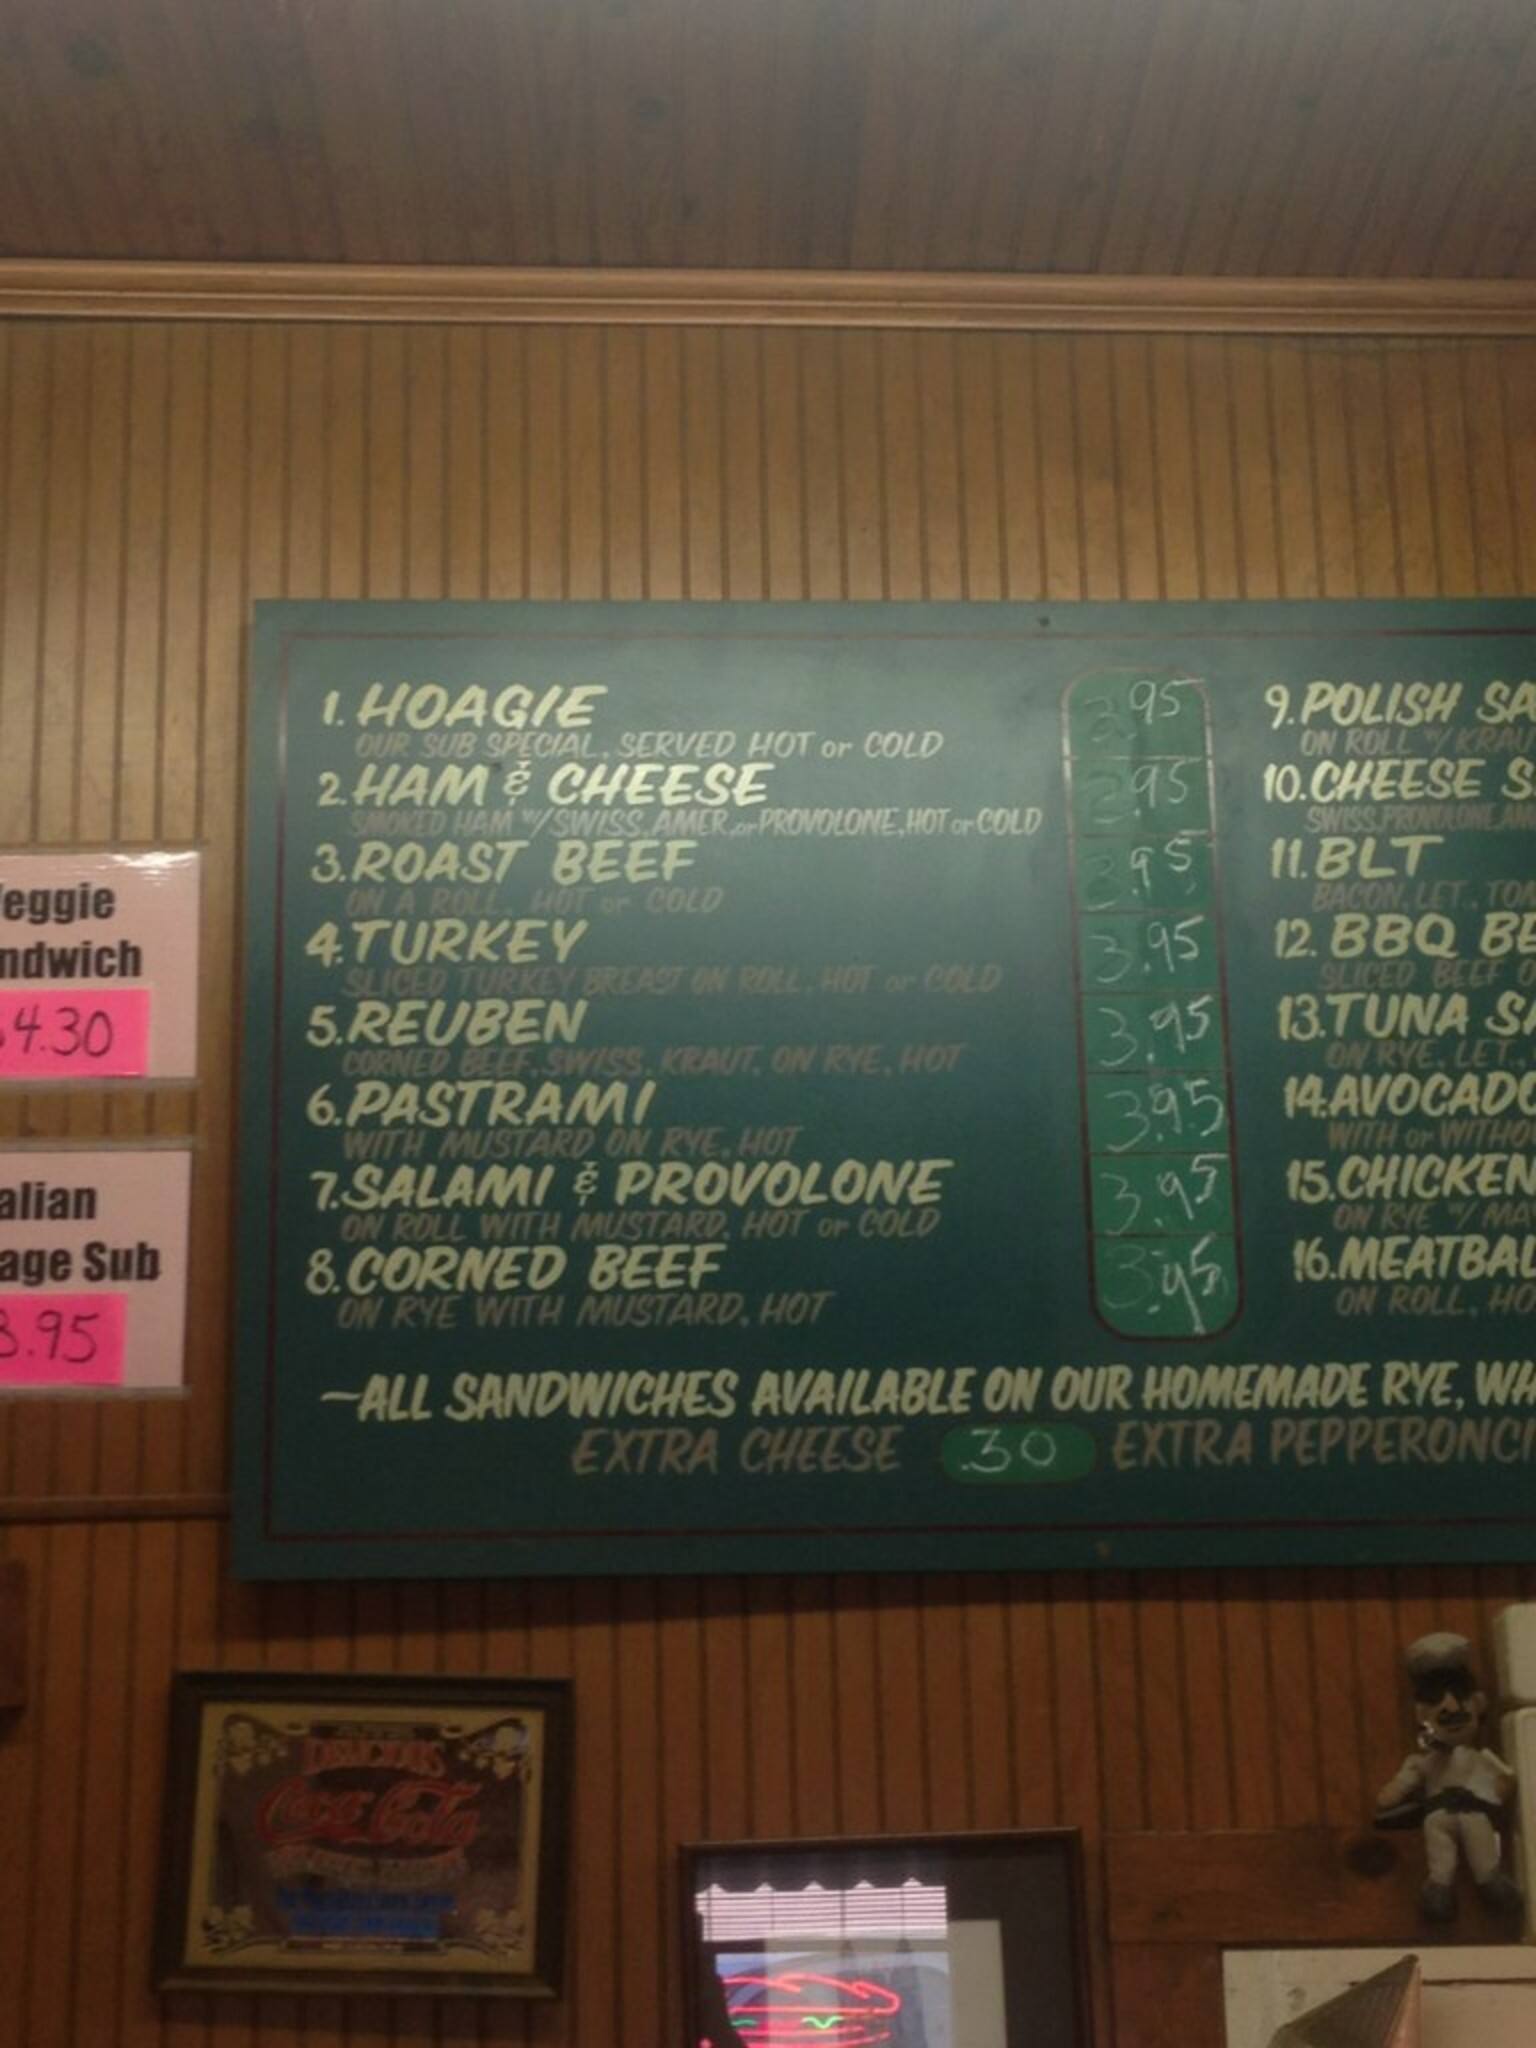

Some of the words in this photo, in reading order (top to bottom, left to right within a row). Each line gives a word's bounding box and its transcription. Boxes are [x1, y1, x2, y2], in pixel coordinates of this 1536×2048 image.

[321, 690, 345, 727] 1.
[357, 682, 608, 730] HOAGIE
[1264, 684, 1295, 731] 9.
[1301, 681, 1463, 728] POLISH
[355, 731, 410, 758] OUR
[423, 731, 477, 758] SUB
[618, 730, 736, 759] SERVED
[749, 730, 816, 758] HOT
[864, 730, 944, 759] COLD
[1300, 727, 1338, 757] ON
[1344, 726, 1411, 757] ROLL
[317, 771, 347, 807] 2.
[352, 763, 491, 807] HAM
[503, 760, 531, 807] &
[546, 762, 775, 807] CHEESE
[1263, 763, 1307, 803] 10.
[1309, 757, 1487, 803] CHEESE
[1500, 755, 1536, 801] S
[350, 808, 446, 838] SMOKED
[453, 808, 513, 837] HAM
[976, 807, 1042, 836] COLD
[310, 843, 347, 883] 3.
[352, 840, 530, 884] ROAST
[553, 839, 698, 885] BEEF
[1271, 837, 1308, 879] 11.
[1314, 834, 1445, 881] BLT
[0, 882, 115, 925] eggie
[345, 887, 386, 917] ON
[394, 887, 415, 916] A
[530, 886, 597, 916] HOT
[645, 886, 724, 915] COLD
[305, 921, 344, 968] 4.
[352, 919, 589, 965] TURKEY
[1088, 916, 1204, 982] 3.95
[1275, 918, 1318, 959] 12.
[1330, 912, 1459, 959] BBQ
[0, 939, 142, 980] ndwich
[341, 966, 447, 997] SLICED
[458, 966, 574, 996] TURKEY
[584, 965, 686, 995] BREAST
[690, 965, 729, 994] ON
[820, 964, 876, 993] HOT
[925, 963, 1003, 994] COLD
[1318, 958, 1416, 991] SLICED
[1431, 957, 1504, 990] BEEF
[306, 1005, 344, 1047] 5.
[347, 999, 589, 1047] REUBEN
[1099, 994, 1213, 1066] 3.95
[1278, 993, 1327, 1041] 13.
[1325, 992, 1470, 1039] TUNA
[342, 1047, 450, 1077] CORNED
[770, 1044, 818, 1075] ON
[901, 1042, 967, 1074] HOT
[306, 1084, 343, 1126] 6.
[346, 1080, 657, 1127] PASTRAMI
[1105, 1078, 1224, 1152] 3.95
[342, 1128, 425, 1161] WITH
[438, 1127, 595, 1160] MUSTARD
[605, 1127, 649, 1158] ON
[738, 1124, 805, 1157] HOT
[1328, 1119, 1400, 1150] WITH
[0, 1181, 97, 1220] alian
[309, 1171, 340, 1211] 7.
[340, 1163, 556, 1211] SALAMI
[573, 1161, 599, 1206] &
[614, 1158, 954, 1207] PROVOLONE
[1100, 1153, 1228, 1235] 3.95
[1286, 1159, 1336, 1204] 15.
[1337, 1153, 1536, 1199] CHICKEN
[341, 1213, 384, 1242] ON
[391, 1212, 467, 1242] ROLL
[479, 1211, 561, 1241] WITH
[740, 1207, 811, 1240] HOT
[858, 1207, 941, 1238] COLD
[1333, 1203, 1374, 1231] ON
[1380, 1202, 1435, 1230] RYE
[0, 1249, 72, 1287] age
[83, 1242, 161, 1282] Sub
[305, 1248, 340, 1295] 8.
[346, 1245, 568, 1295] CORNED
[588, 1243, 728, 1292] BEEF
[337, 1297, 384, 1329] ON
[391, 1296, 458, 1329] RYE
[475, 1295, 564, 1328] WITH
[760, 1290, 836, 1326] HOT
[1336, 1285, 1378, 1317] ON
[445, 1369, 739, 1420] SANDWICHES
[751, 1367, 977, 1417] AVAILABLE
[983, 1366, 1043, 1412] ON
[1050, 1364, 1134, 1411] OUR
[1143, 1362, 1371, 1411] HOMEMADE
[1381, 1360, 1464, 1411] RYE,
[570, 1426, 719, 1476] EXTRA
[739, 1424, 903, 1474] CHEESE
[1112, 1417, 1253, 1470] EXTRA
